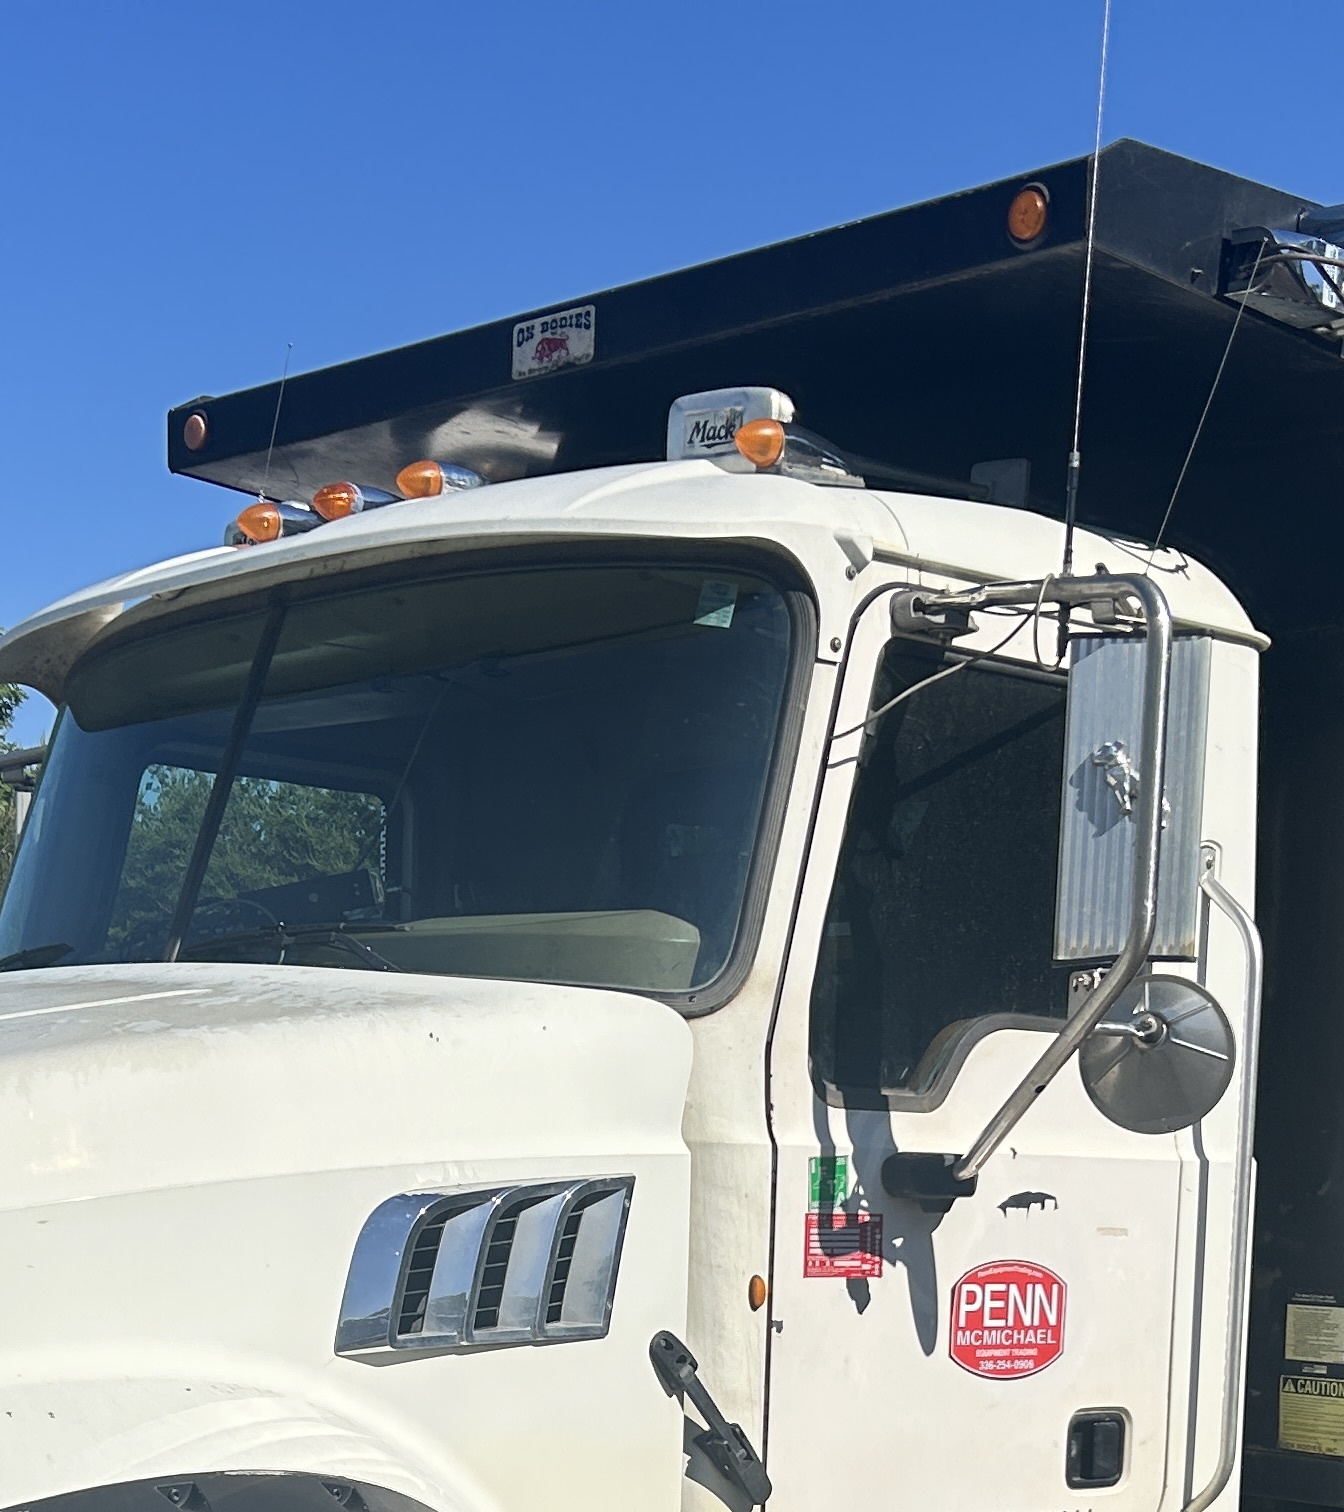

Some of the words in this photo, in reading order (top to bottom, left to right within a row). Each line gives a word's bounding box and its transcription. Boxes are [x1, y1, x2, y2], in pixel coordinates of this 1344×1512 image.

[517, 325, 535, 348] OX
[540, 310, 591, 334] BODIES
[687, 417, 736, 444] Mack
[958, 1283, 1059, 1328] PENN
[956, 1329, 1057, 1346] MCMICHAEL
